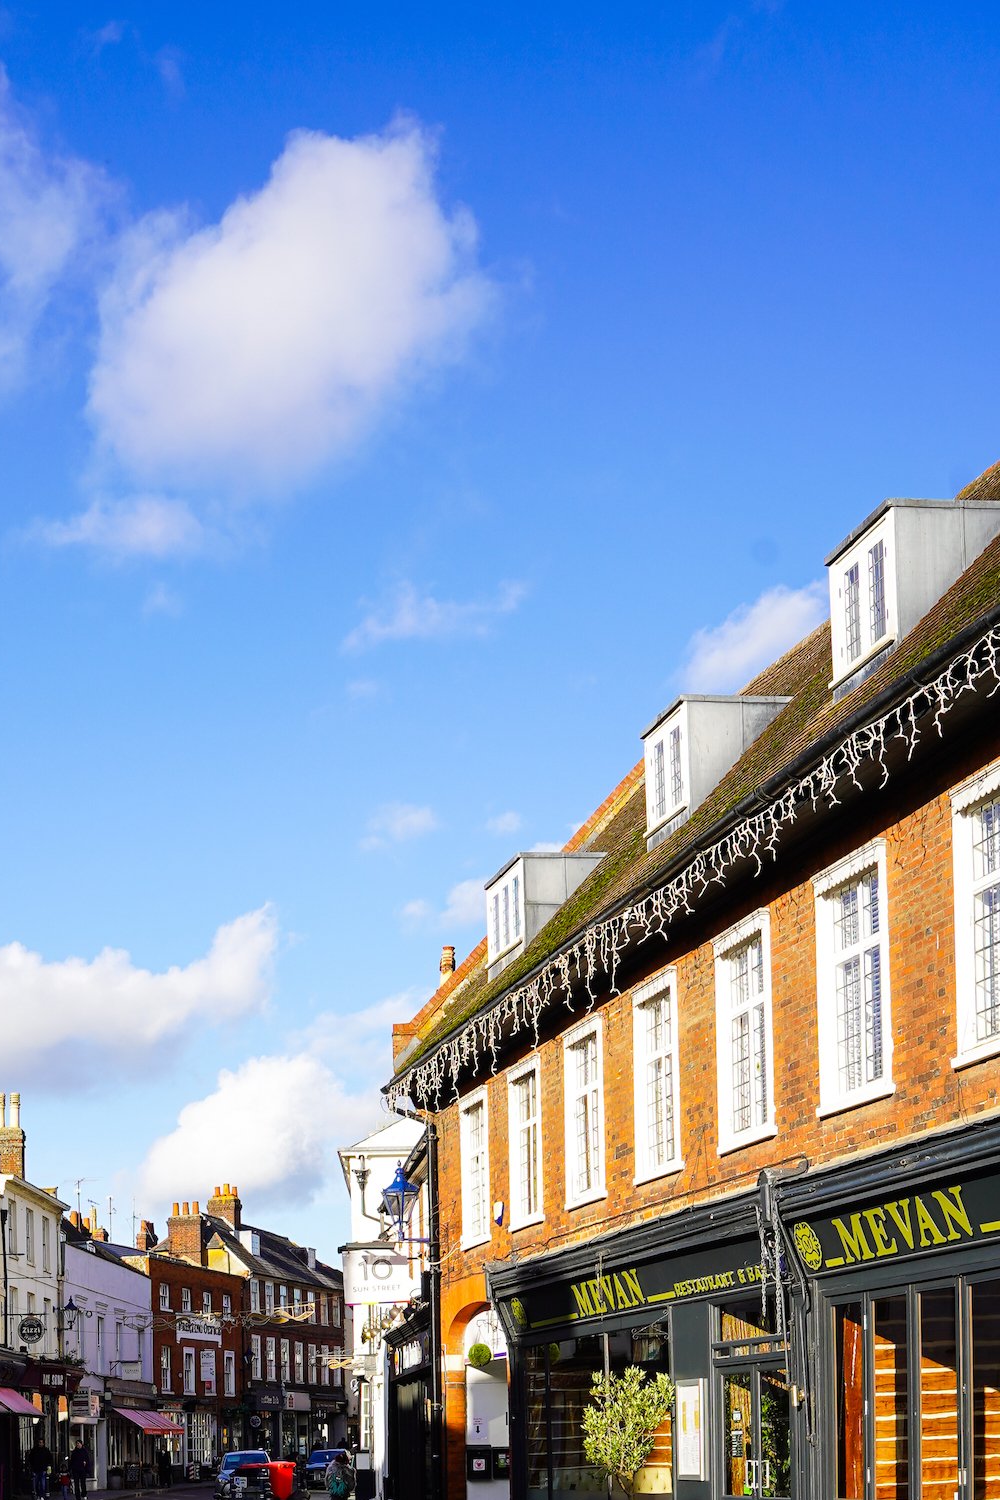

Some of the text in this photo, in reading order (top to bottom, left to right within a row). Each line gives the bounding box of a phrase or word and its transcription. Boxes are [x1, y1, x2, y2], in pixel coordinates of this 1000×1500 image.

[832, 1185, 974, 1264] MEVAN
[358, 1258, 393, 1281] 10
[373, 1285, 401, 1293] STREET
[571, 1269, 646, 1318] MEVAN
[673, 1271, 736, 1298] RESTAURANT
